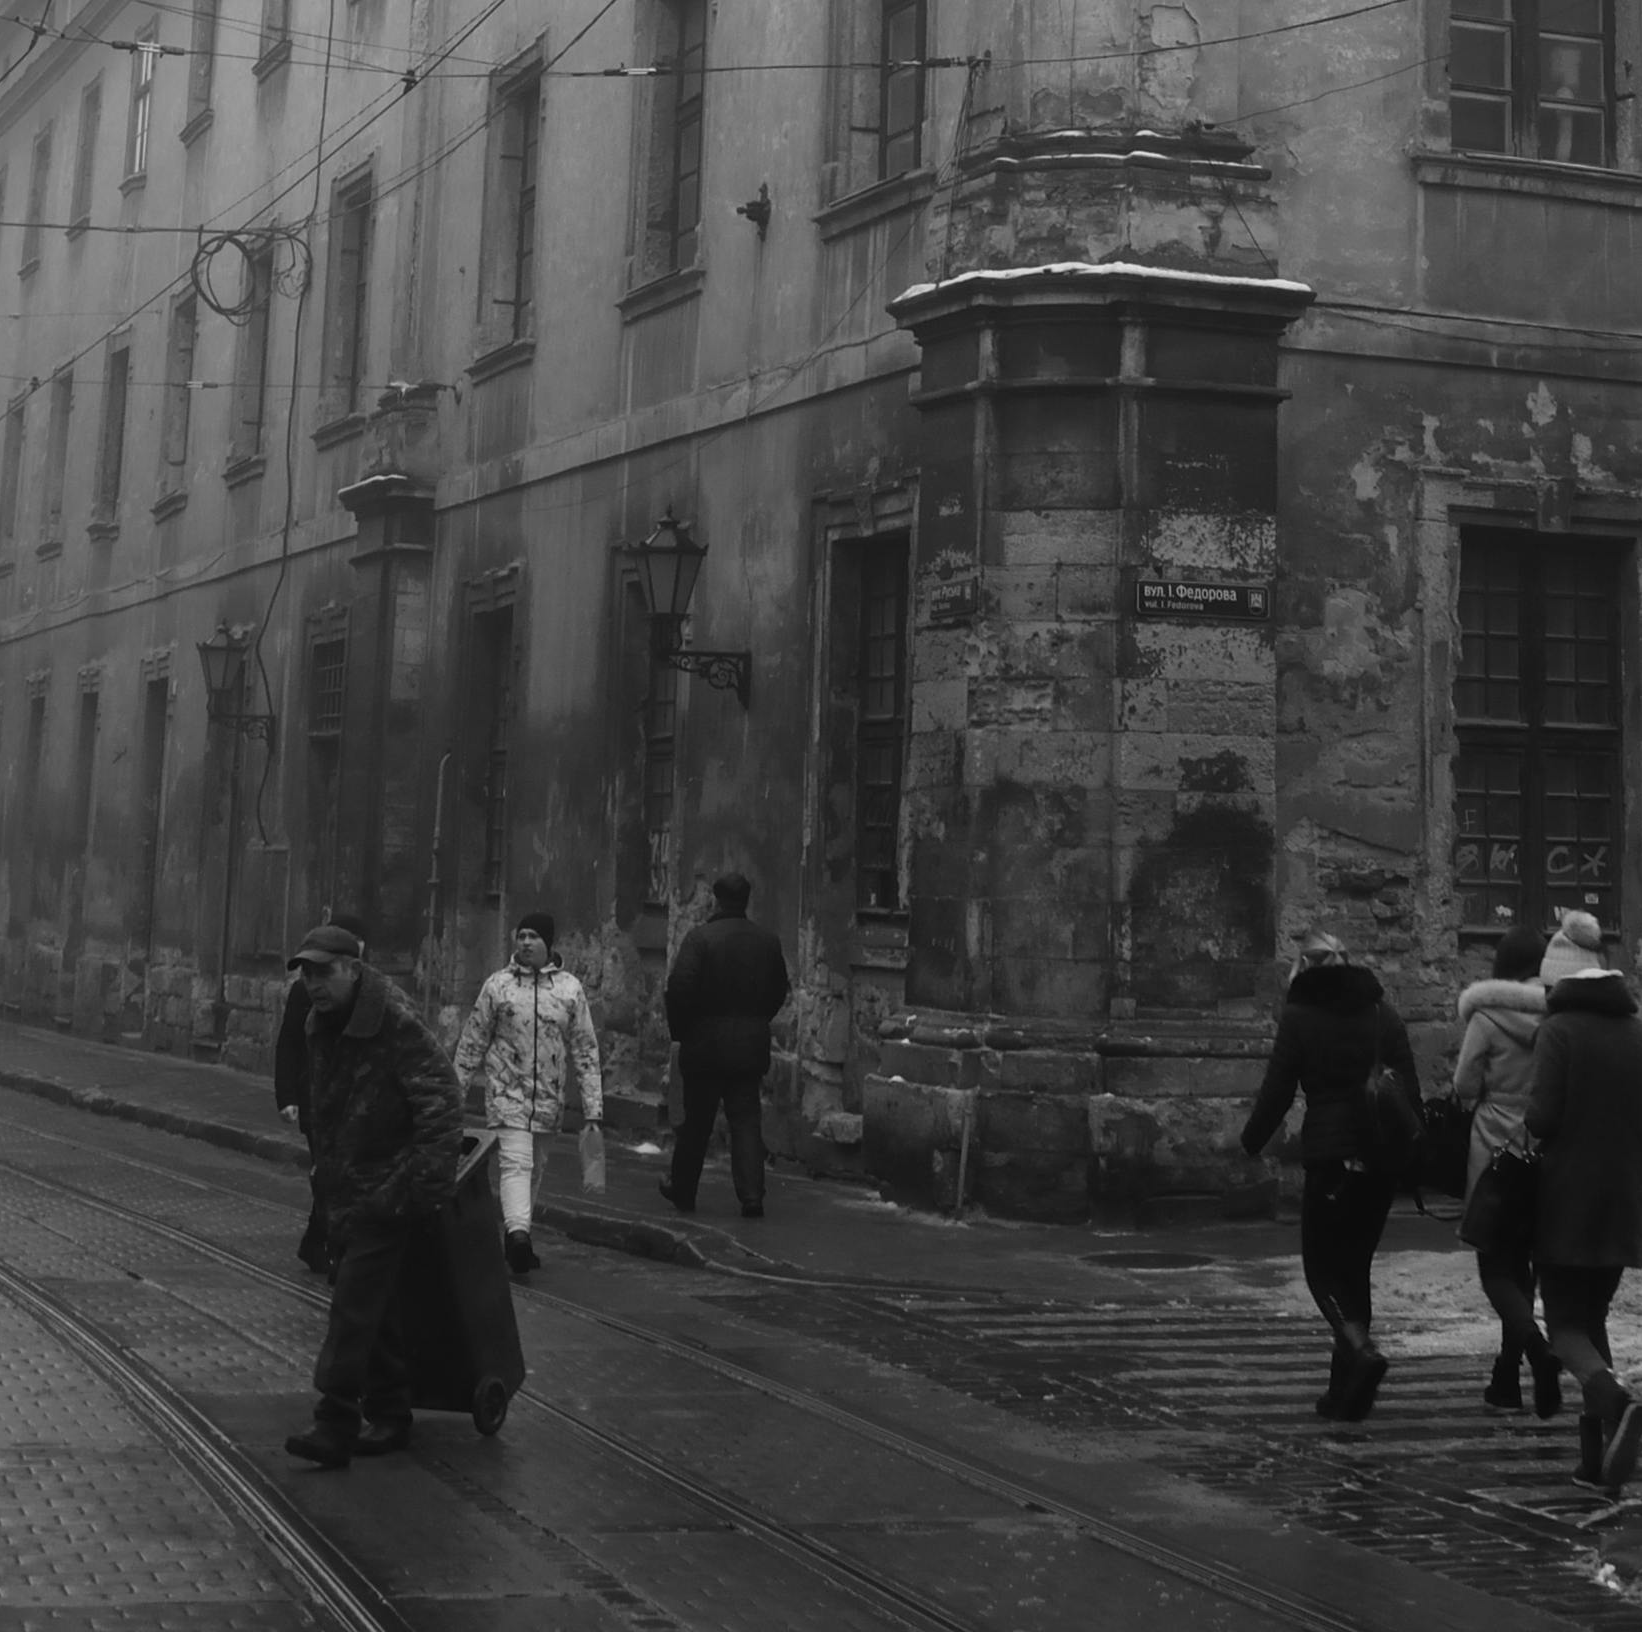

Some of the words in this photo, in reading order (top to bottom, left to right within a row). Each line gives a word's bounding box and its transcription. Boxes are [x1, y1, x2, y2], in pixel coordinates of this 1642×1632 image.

[1144, 585, 1166, 597] вул.
[1176, 584, 1237, 602] Федорова
[1167, 600, 1204, 611] Fedorova
